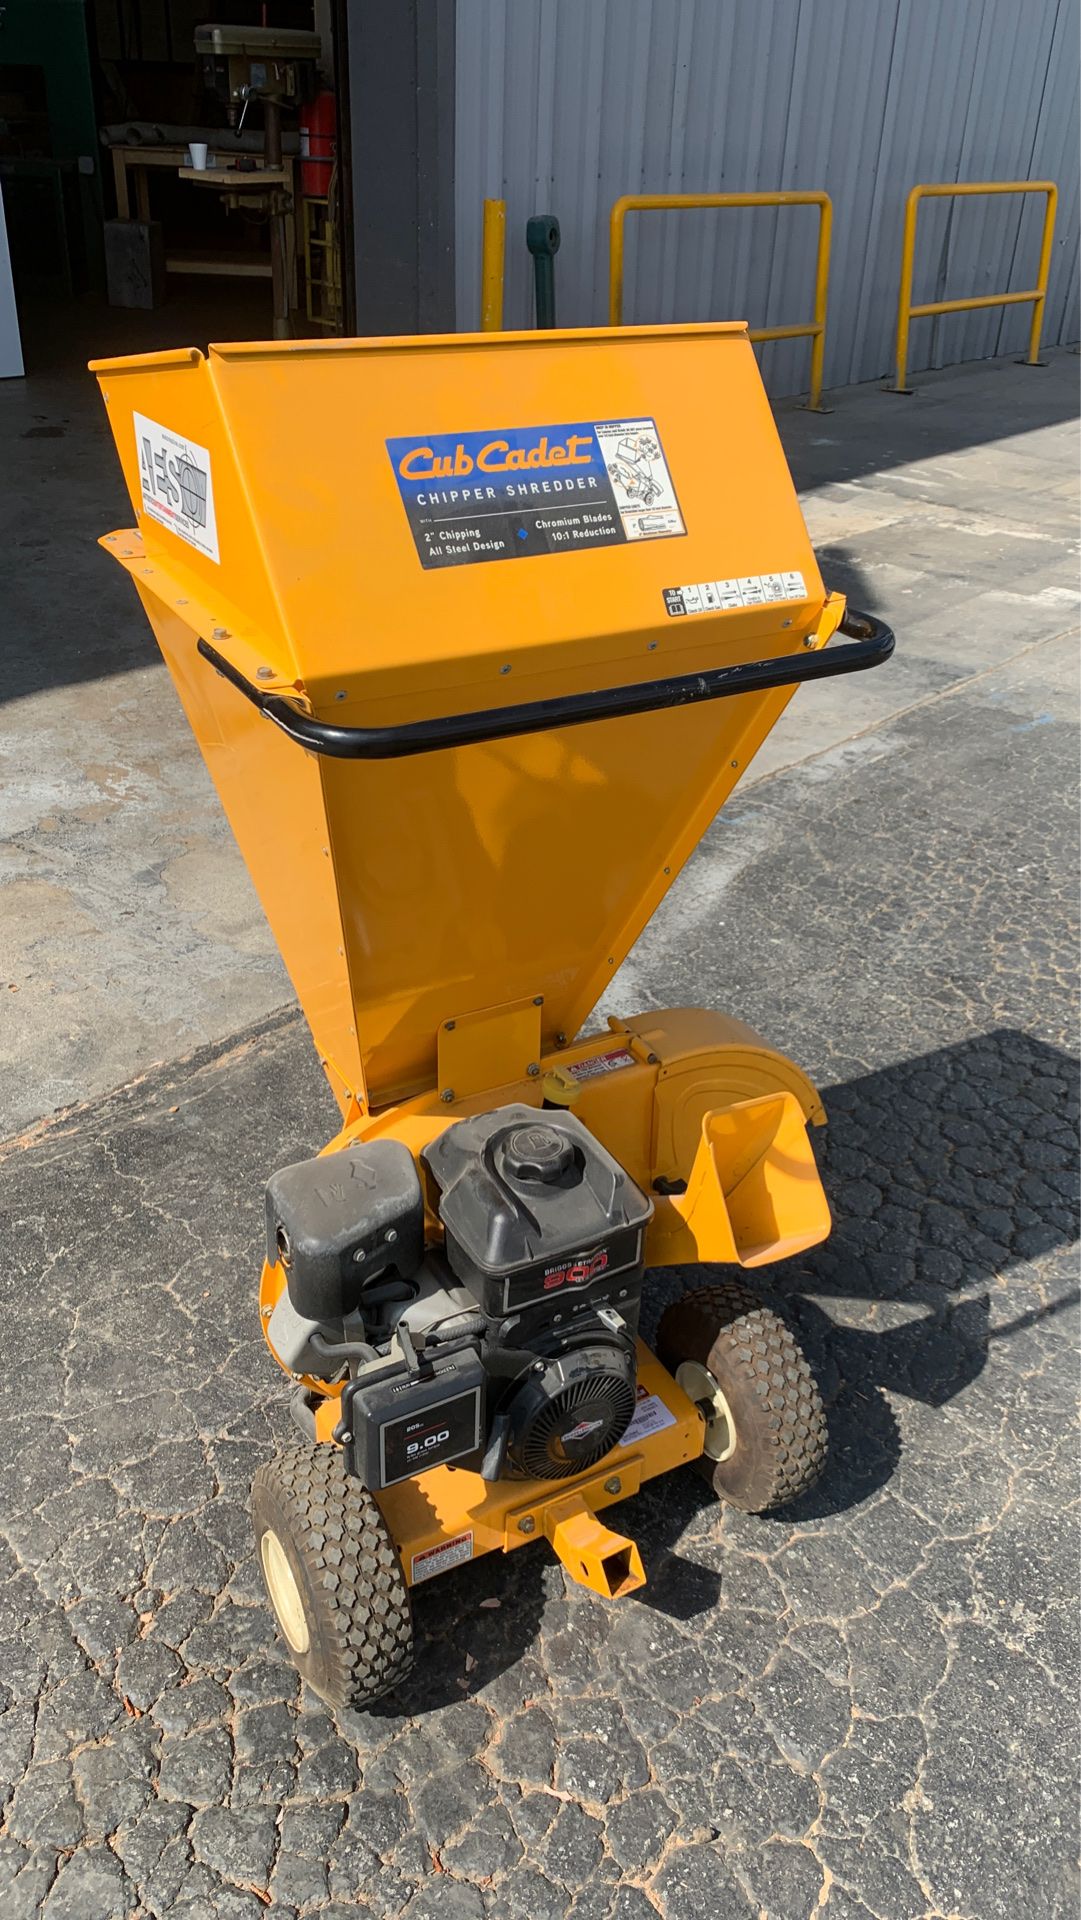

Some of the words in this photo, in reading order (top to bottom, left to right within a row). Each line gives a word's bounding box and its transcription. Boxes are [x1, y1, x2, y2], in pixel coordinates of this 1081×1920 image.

[399, 444, 474, 480] Cub
[476, 435, 592, 473] Cadet
[417, 488, 496, 506] CHIPPER
[506, 476, 598, 496] SHREDDER
[535, 516, 581, 529] Chromium
[583, 513, 613, 524] Blades
[424, 532, 435, 542] 2"
[439, 528, 481, 541] Chipping
[552, 531, 570, 541] 10:1
[573, 525, 616, 538] Reduction
[429, 547, 443, 556] All
[446, 543, 470, 554] Steel
[473, 539, 505, 553] Design
[406, 1430, 450, 1455] 9.00
[428, 1537, 467, 1556] WARNING
